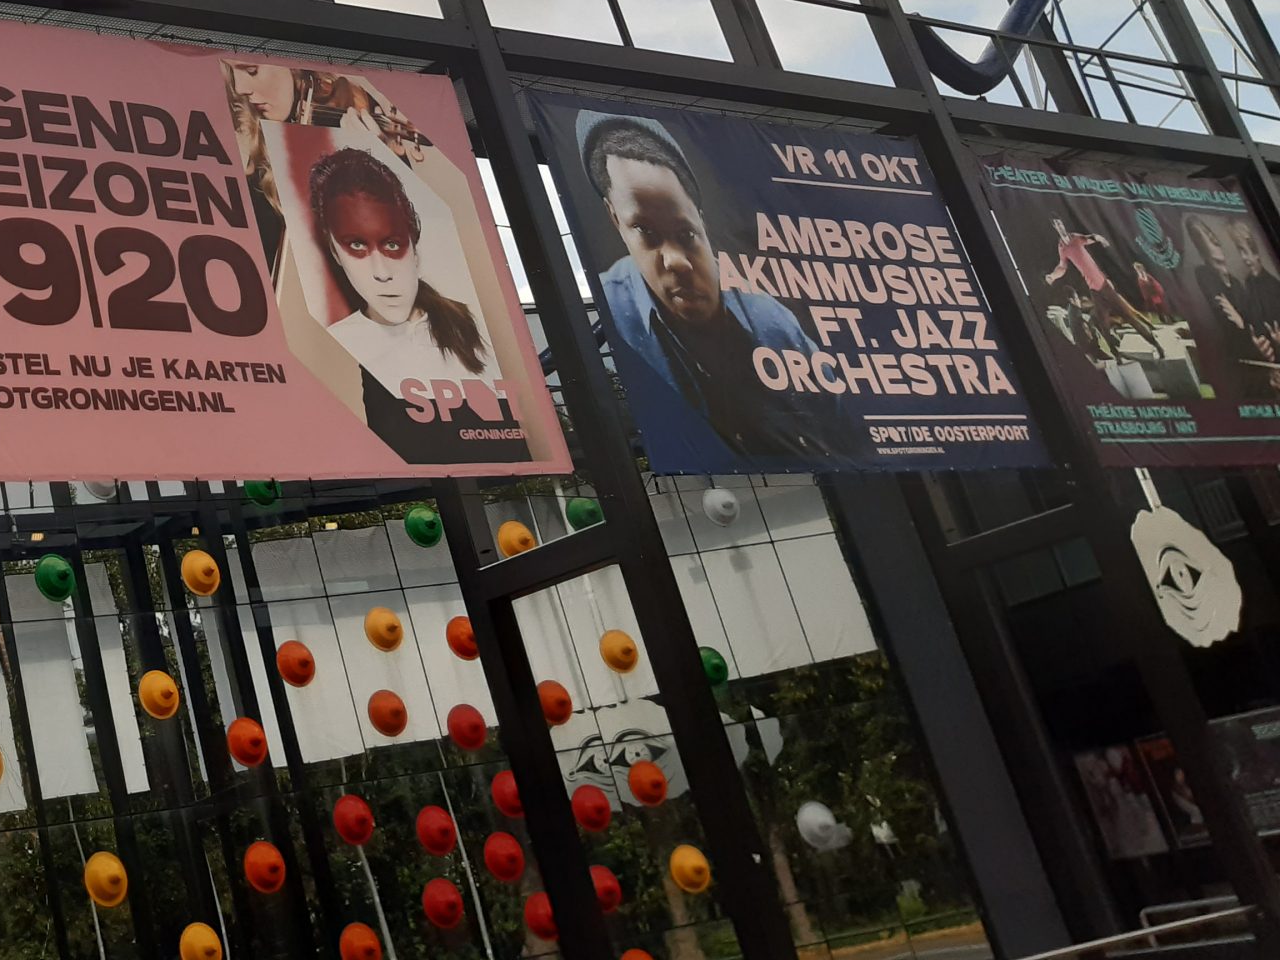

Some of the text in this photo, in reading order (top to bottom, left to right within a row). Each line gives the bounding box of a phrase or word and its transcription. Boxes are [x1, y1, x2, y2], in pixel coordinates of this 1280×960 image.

[771, 143, 922, 185] VR 11 OKT
[984, 164, 1050, 186] THEATER
[756, 212, 962, 264] AMBROSE
[718, 251, 980, 307] AKINMUSIRE
[809, 306, 998, 350] FT. JAZZ
[70, 355, 111, 378] NU
[122, 356, 154, 380] JE
[162, 358, 287, 384] KAARTEN
[752, 347, 1016, 395] ORCHESTRA
[460, 428, 529, 440] GRONINGEN
[934, 424, 1030, 442] OOSTERPOORT
